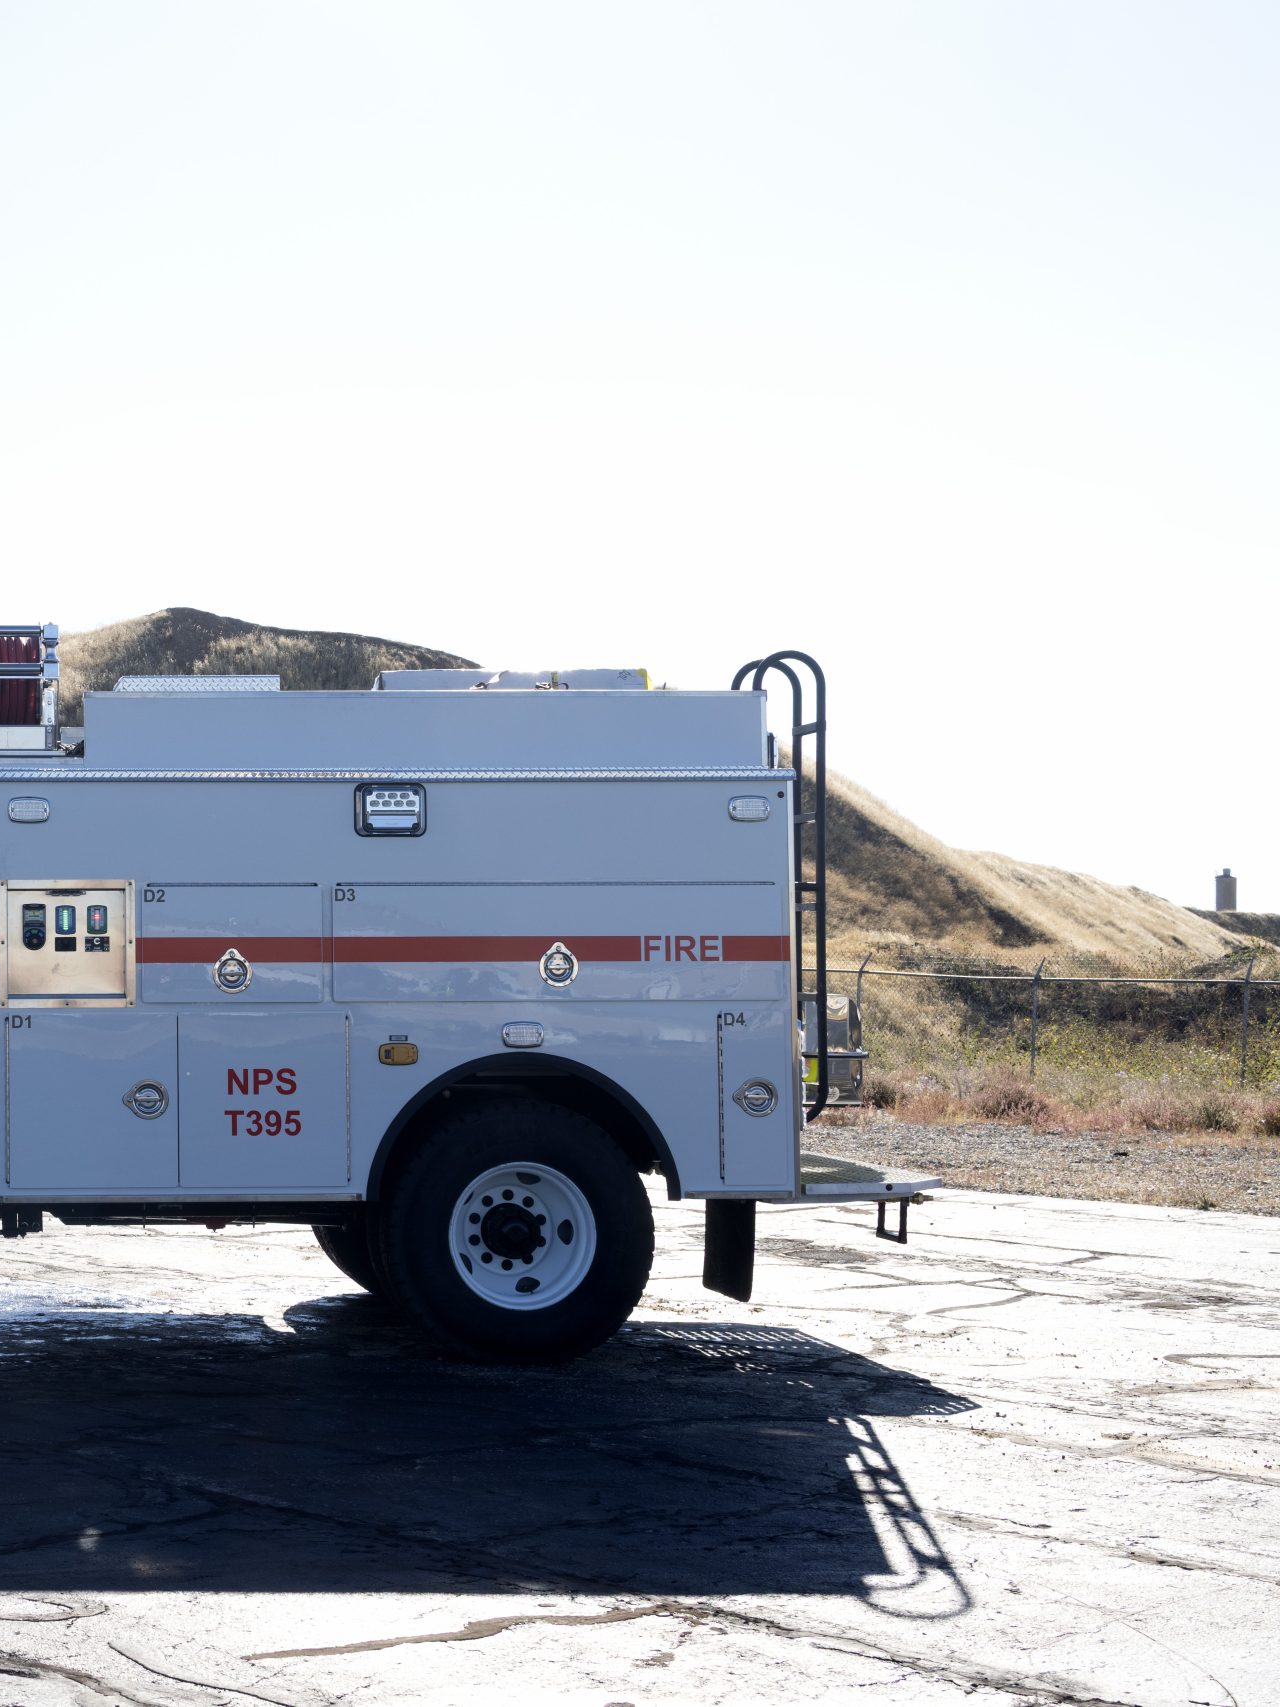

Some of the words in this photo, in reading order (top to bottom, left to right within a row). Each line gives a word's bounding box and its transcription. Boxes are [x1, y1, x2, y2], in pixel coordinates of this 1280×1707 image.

[143, 889, 166, 903] D2
[335, 888, 356, 902] D3
[644, 936, 720, 961] FIRE
[11, 1015, 32, 1029] D1
[723, 1012, 745, 1026] D4
[227, 1067, 297, 1096] NPS
[224, 1109, 302, 1137] T395
